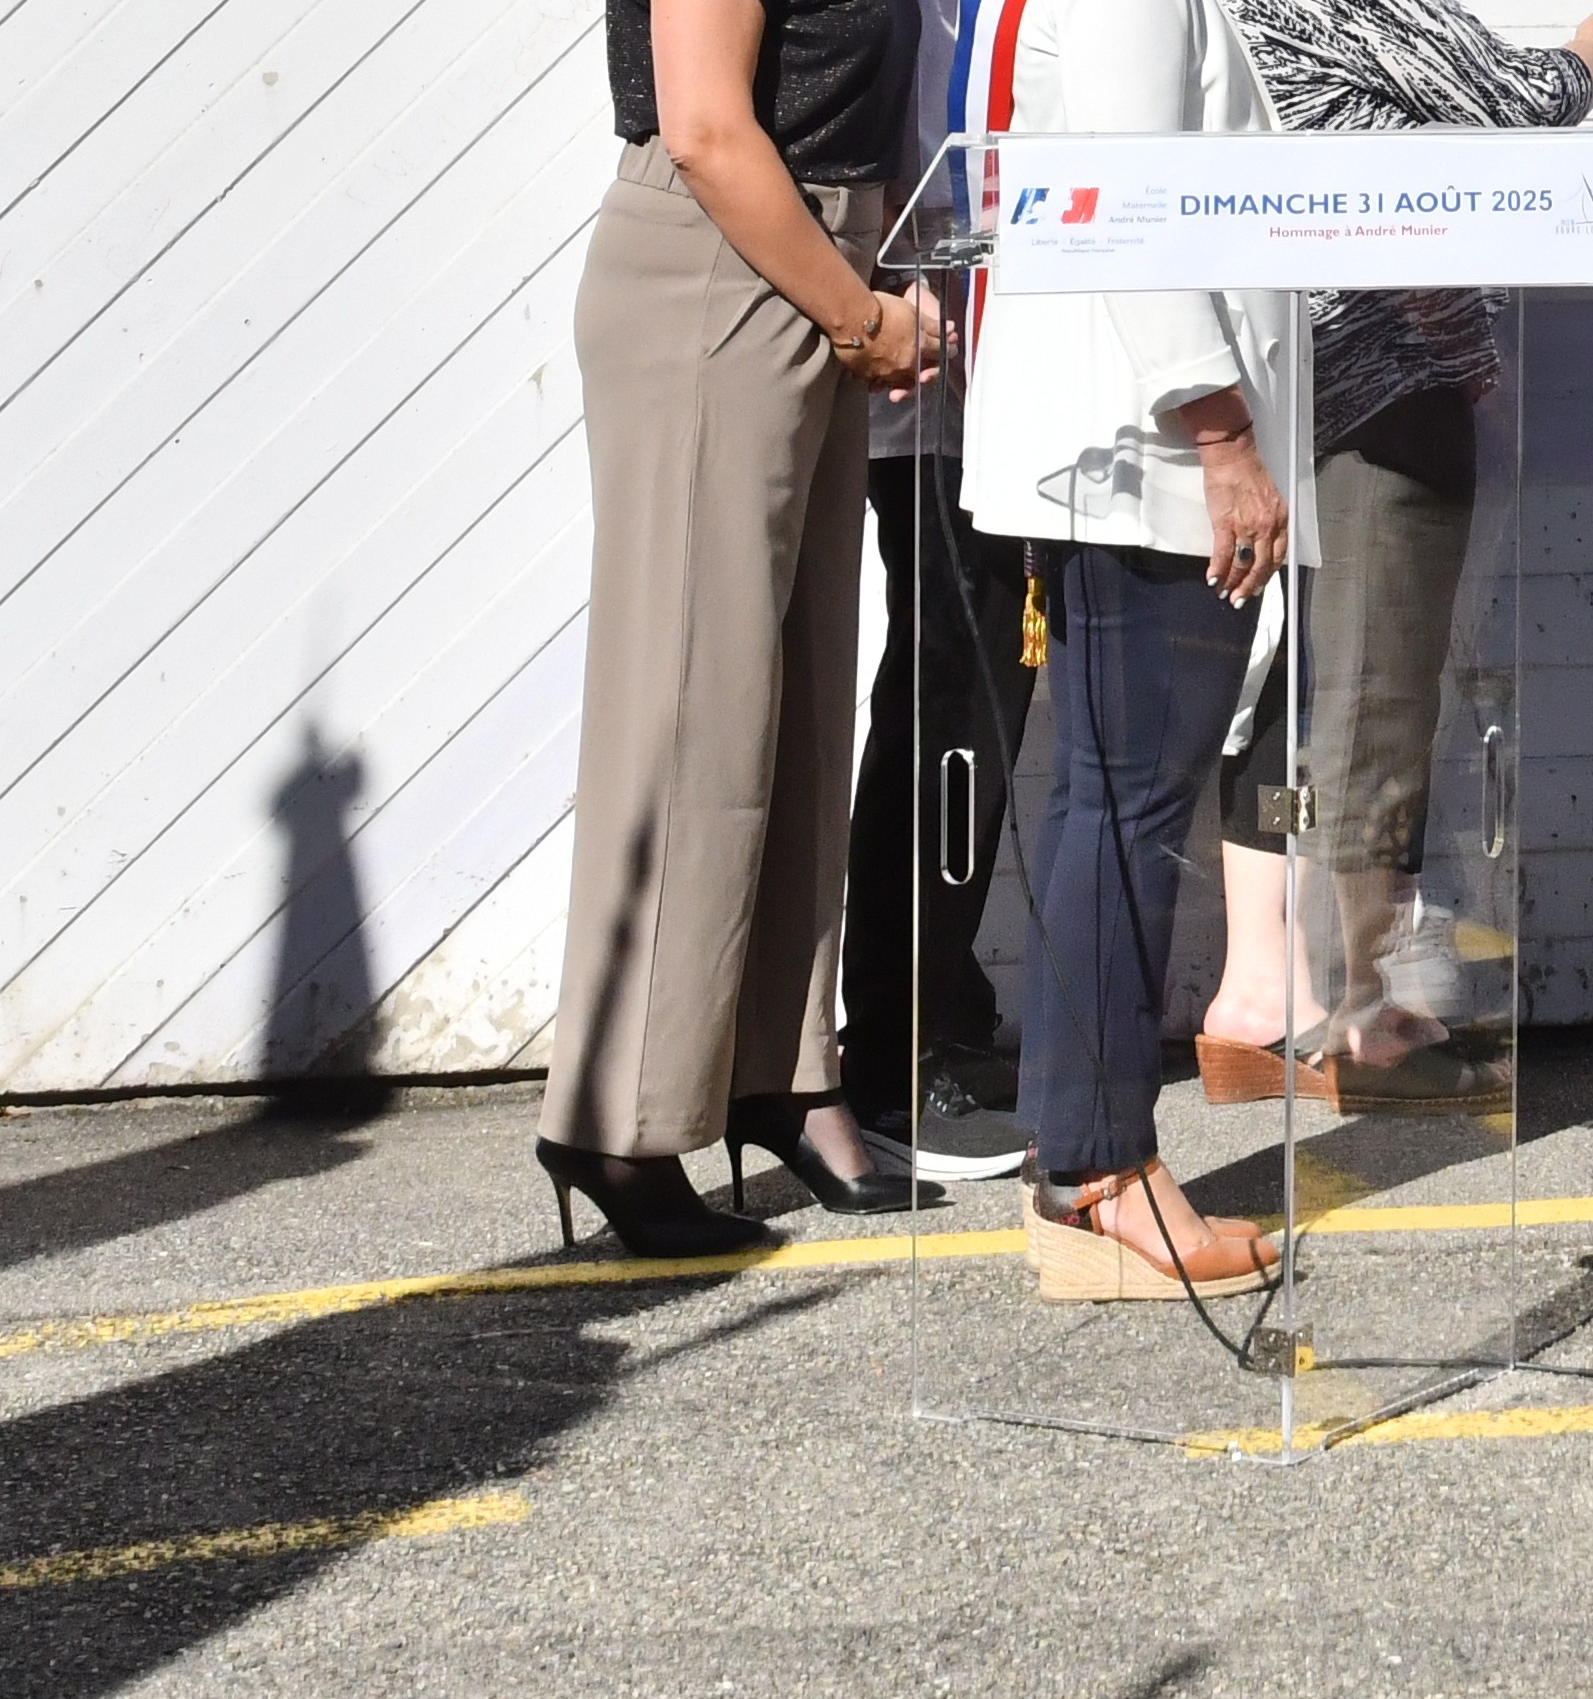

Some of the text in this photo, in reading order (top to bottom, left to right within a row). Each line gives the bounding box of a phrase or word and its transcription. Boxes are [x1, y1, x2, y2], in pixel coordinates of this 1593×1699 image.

[1180, 185, 1553, 216] DIMANCHE 31 AOÛT 2025
[1269, 225, 1448, 240] Hommage à André Munier
